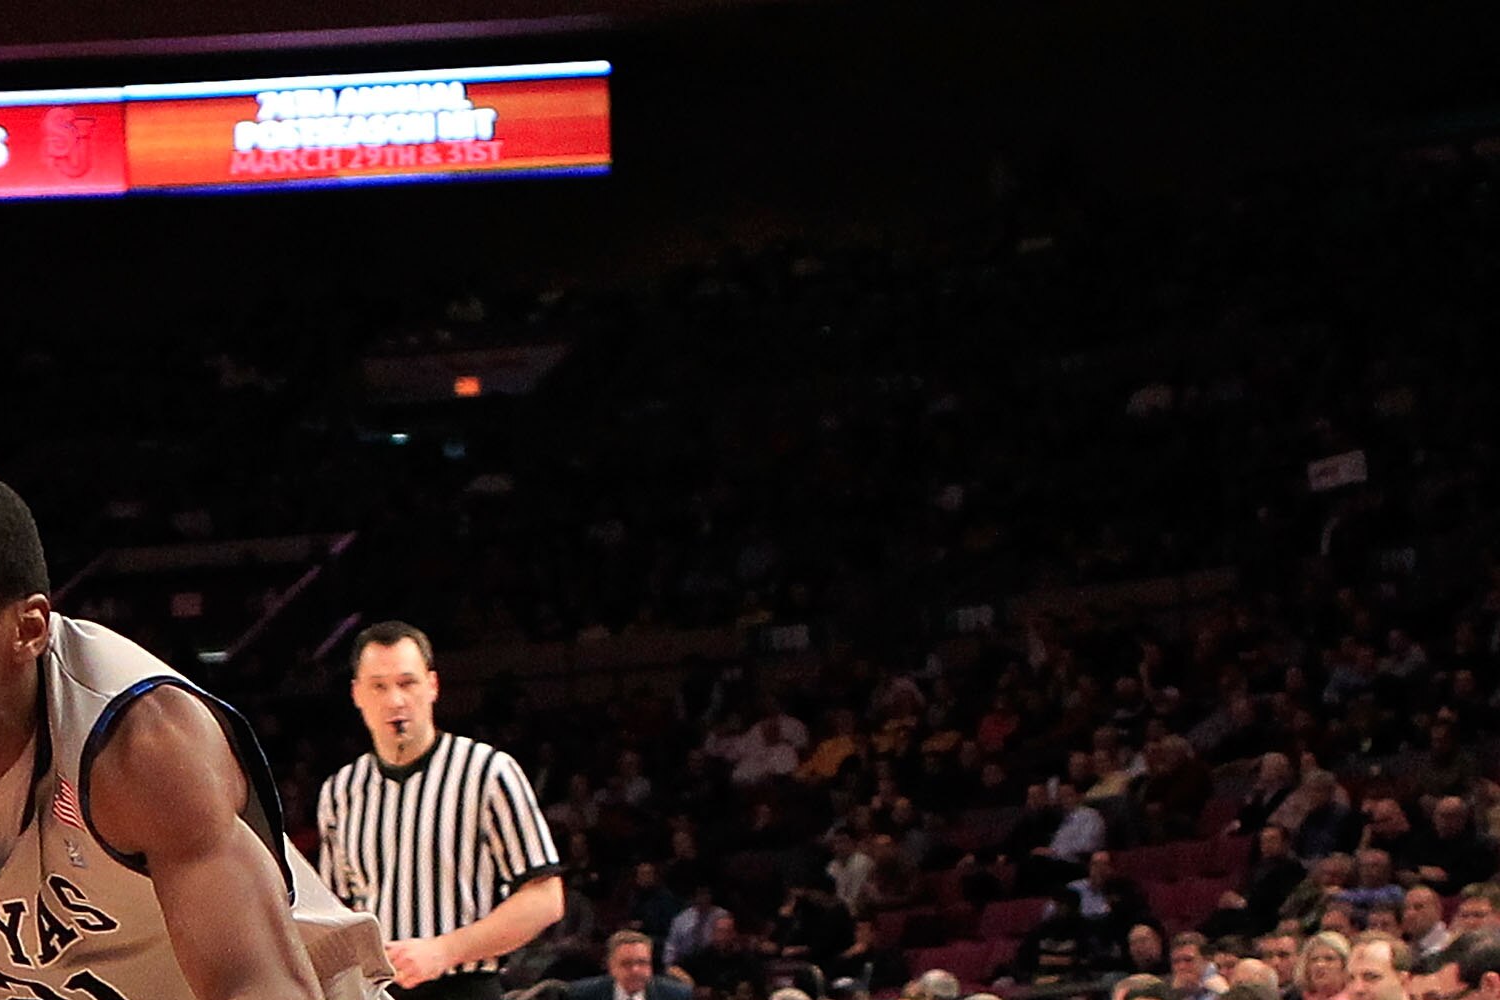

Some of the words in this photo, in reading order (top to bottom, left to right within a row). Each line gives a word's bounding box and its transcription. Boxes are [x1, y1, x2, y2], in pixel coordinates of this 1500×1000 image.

[230, 148, 342, 174] MARCH
[348, 144, 415, 169] 29TH
[417, 143, 440, 165] &
[449, 139, 503, 163] 31ST
